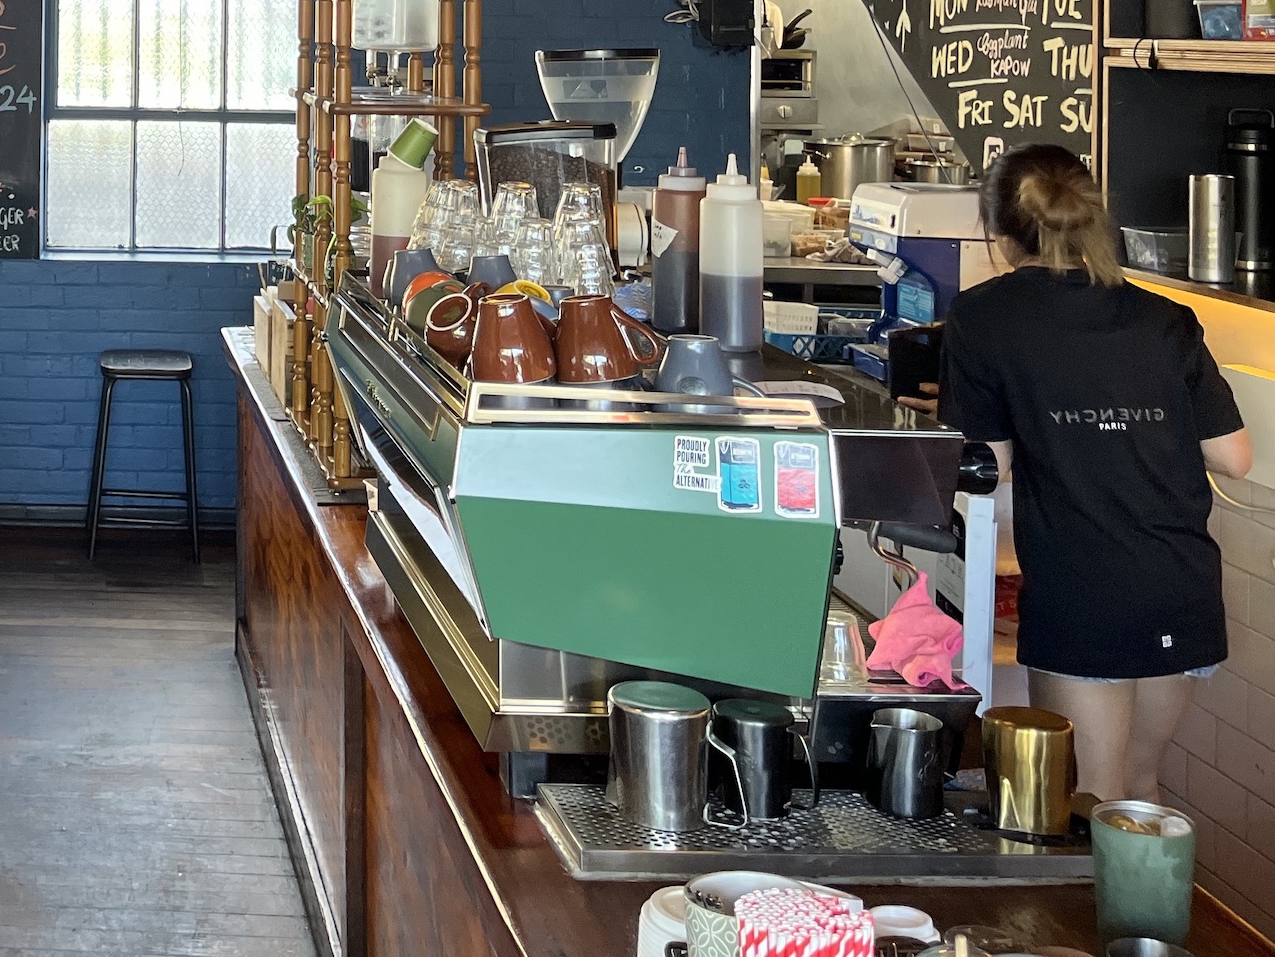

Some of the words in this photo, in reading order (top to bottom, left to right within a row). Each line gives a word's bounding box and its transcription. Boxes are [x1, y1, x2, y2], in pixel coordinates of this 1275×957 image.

[931, 40, 974, 79] WED
[1043, 37, 1092, 81] THU
[990, 55, 1031, 79] KAPOW
[958, 89, 994, 130] FRI
[1002, 89, 1048, 129] SAT
[1059, 97, 1092, 133] SU
[1098, 422, 1127, 431] PARIS
[677, 438, 707, 452] PROUDLY
[676, 451, 707, 464] POURING
[677, 463, 692, 474] The
